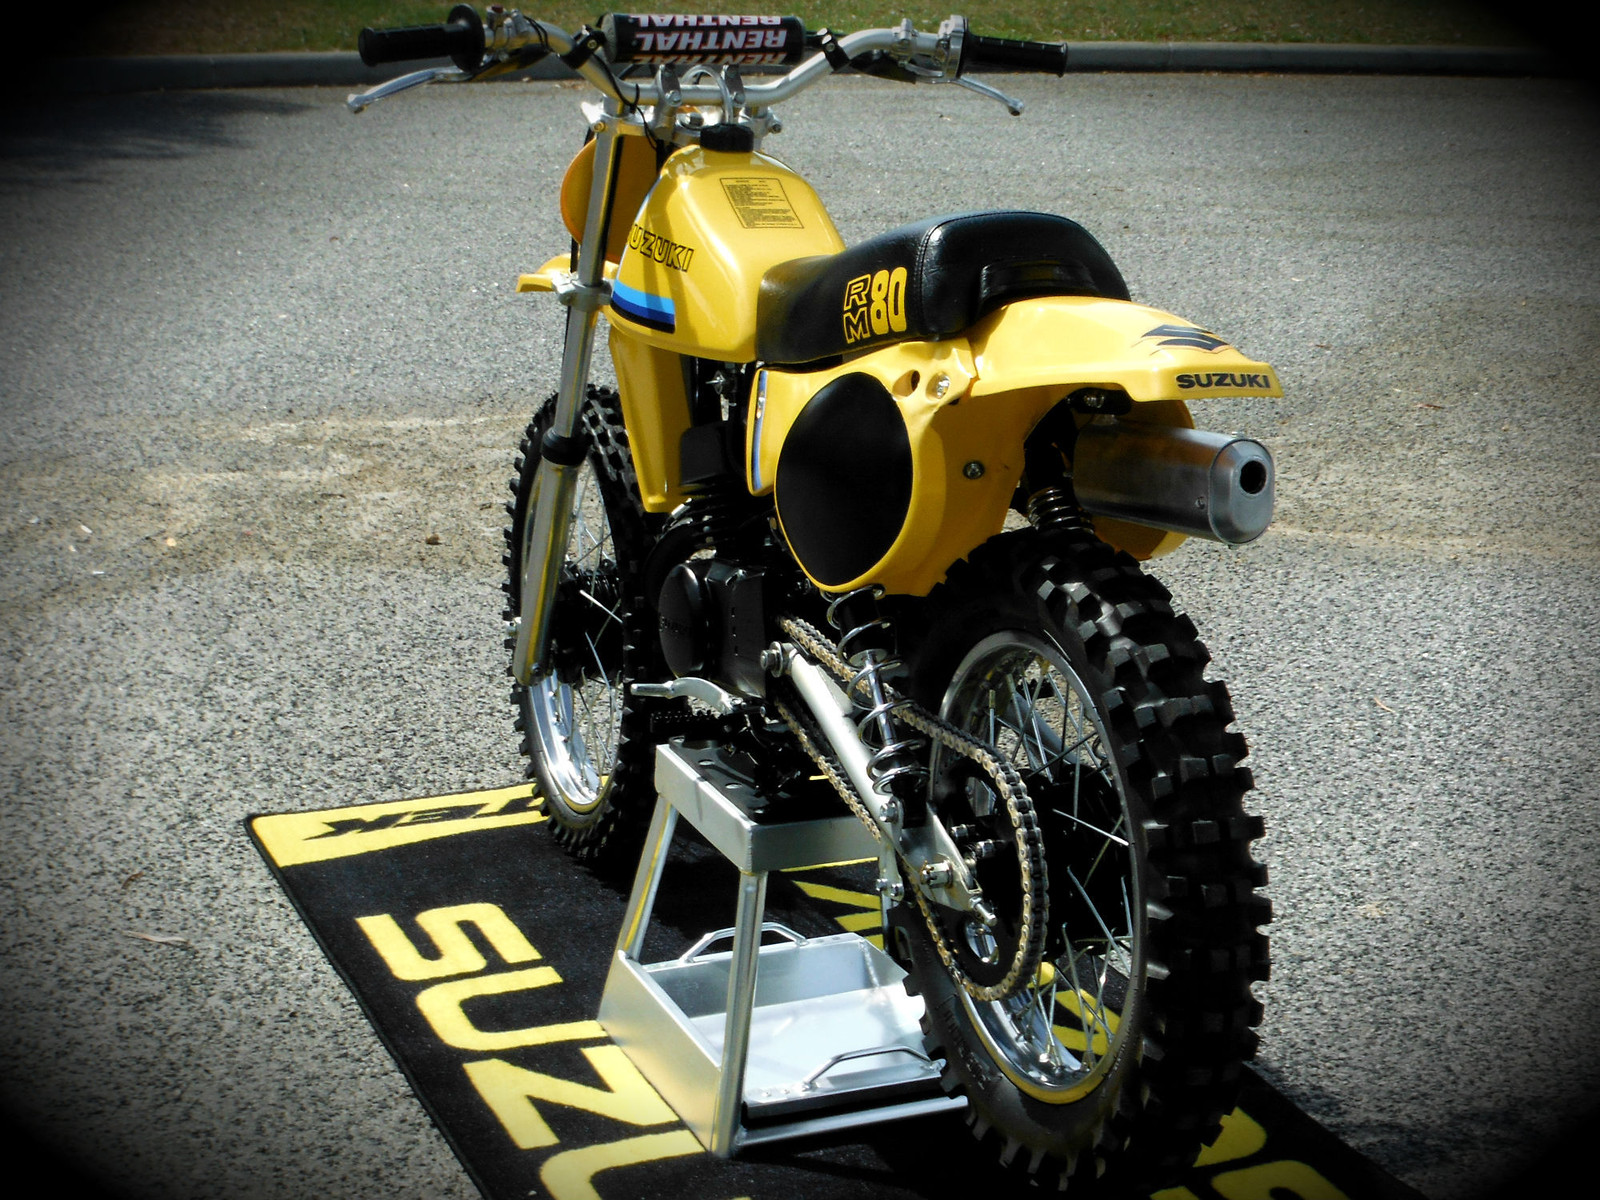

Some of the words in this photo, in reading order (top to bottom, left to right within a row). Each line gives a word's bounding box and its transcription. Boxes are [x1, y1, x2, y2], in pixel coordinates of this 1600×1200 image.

[634, 29, 788, 51] RENTHAL
[628, 224, 695, 273] UZUKI
[870, 266, 908, 336] 80
[1175, 372, 1271, 389] SUZUKI
